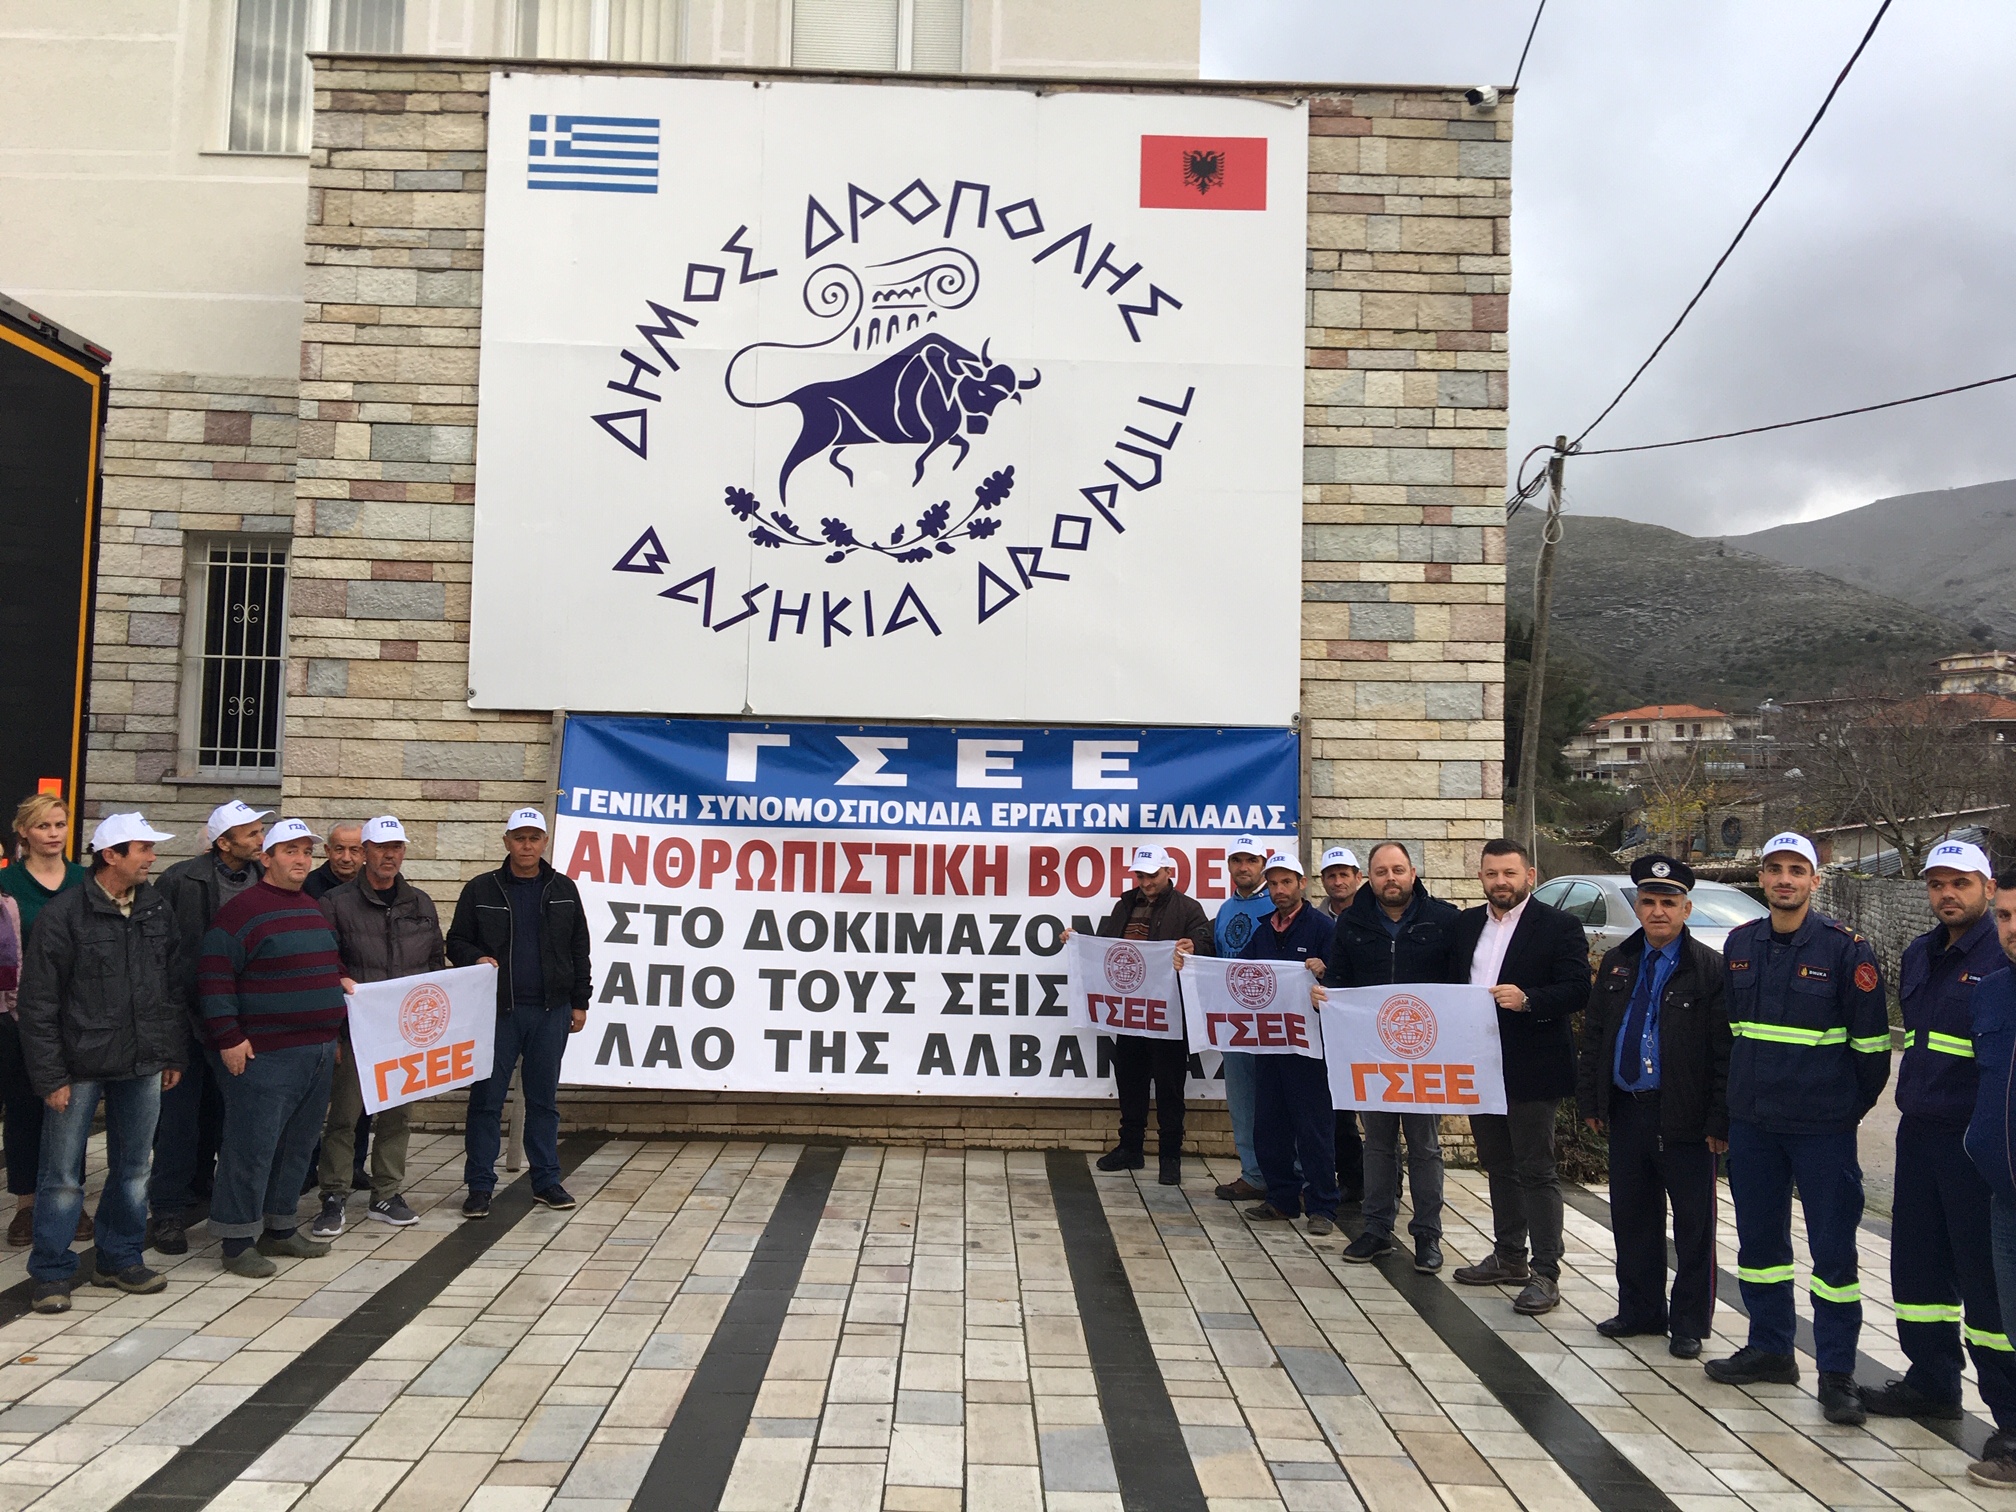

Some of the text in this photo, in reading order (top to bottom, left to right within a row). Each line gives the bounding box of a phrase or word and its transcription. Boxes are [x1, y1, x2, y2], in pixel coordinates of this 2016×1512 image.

[591, 178, 1183, 461] ΔΗΜΟΣ ΔΡΟΠΟΛΗΣ
[611, 525, 942, 648] BASHKIA
[571, 787, 1286, 830] ΓΕΝΙΚΗ ΣΥΝΟΜΟΣΠΟΝΔΙΑ ΕΡΓΑΤΩΝ ΕΛΛΑΔΑΣ
[565, 830, 1236, 900] ΑΝΘΡΩΠΙΣΤΙΚΗ ΒΟΗΕ
[1773, 837, 1799, 846] ΓΣΕΕ
[1936, 845, 1964, 856] ΓΣΕΕ
[604, 901, 724, 949] ΣΤΟ
[598, 961, 735, 1009] ΑΠΟ
[758, 968, 916, 1014] ΤΟΥΣ
[1087, 993, 1169, 1032] ΓΣΕΕ
[1206, 1012, 1310, 1049] ΓΣΕΕ
[374, 1039, 475, 1103] ΓΣΕΕ
[594, 1022, 735, 1071] ΛΑΟ
[764, 1029, 889, 1075] ΤΗΣ
[1351, 1063, 1480, 1105] ΓΣΕΕ
